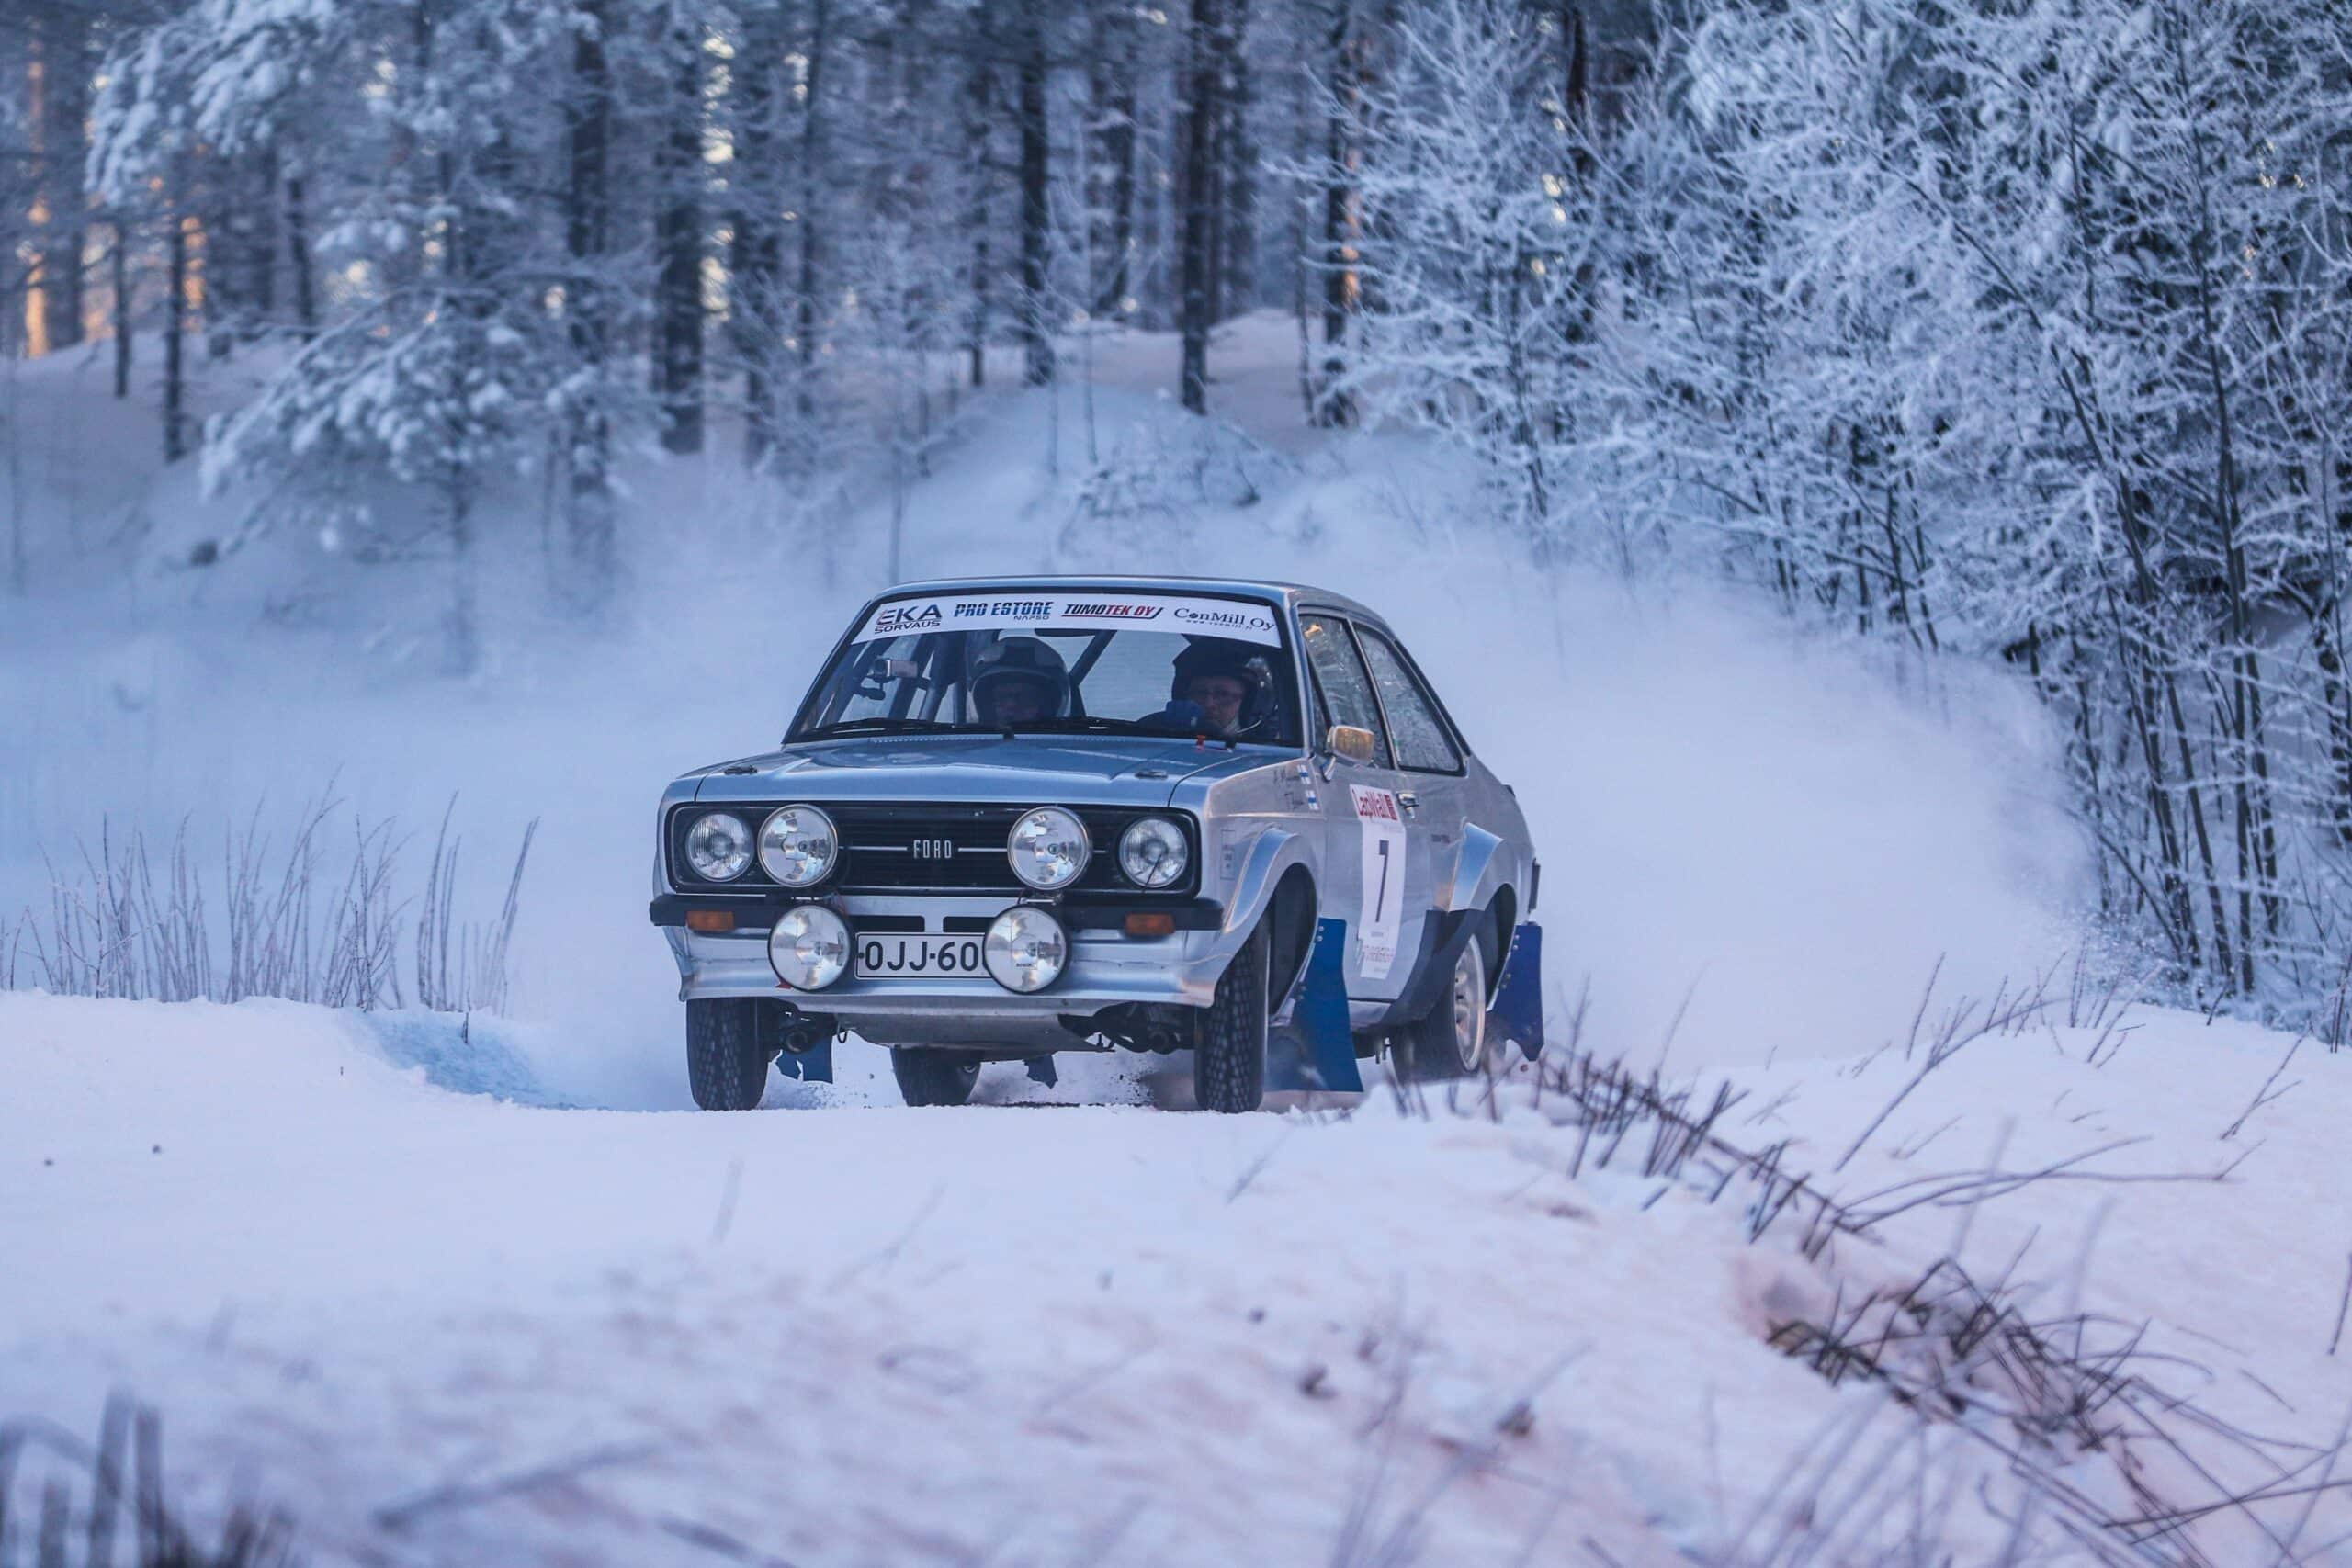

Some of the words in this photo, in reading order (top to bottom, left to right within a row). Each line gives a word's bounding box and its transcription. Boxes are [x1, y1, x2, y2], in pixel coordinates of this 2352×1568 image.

[876, 604, 942, 626] EKA
[954, 603, 988, 617] PRO
[990, 601, 1054, 616] ESTORE
[1063, 604, 1131, 615] TUMOTEK
[1134, 605, 1155, 616] OY
[874, 620, 942, 635] SORVAUS
[1173, 607, 1246, 626] ConMill
[1250, 616, 1276, 632] Oy
[912, 840, 953, 859] FORD
[1374, 840, 1390, 923] 7
[864, 940, 979, 972] OJJ-60
